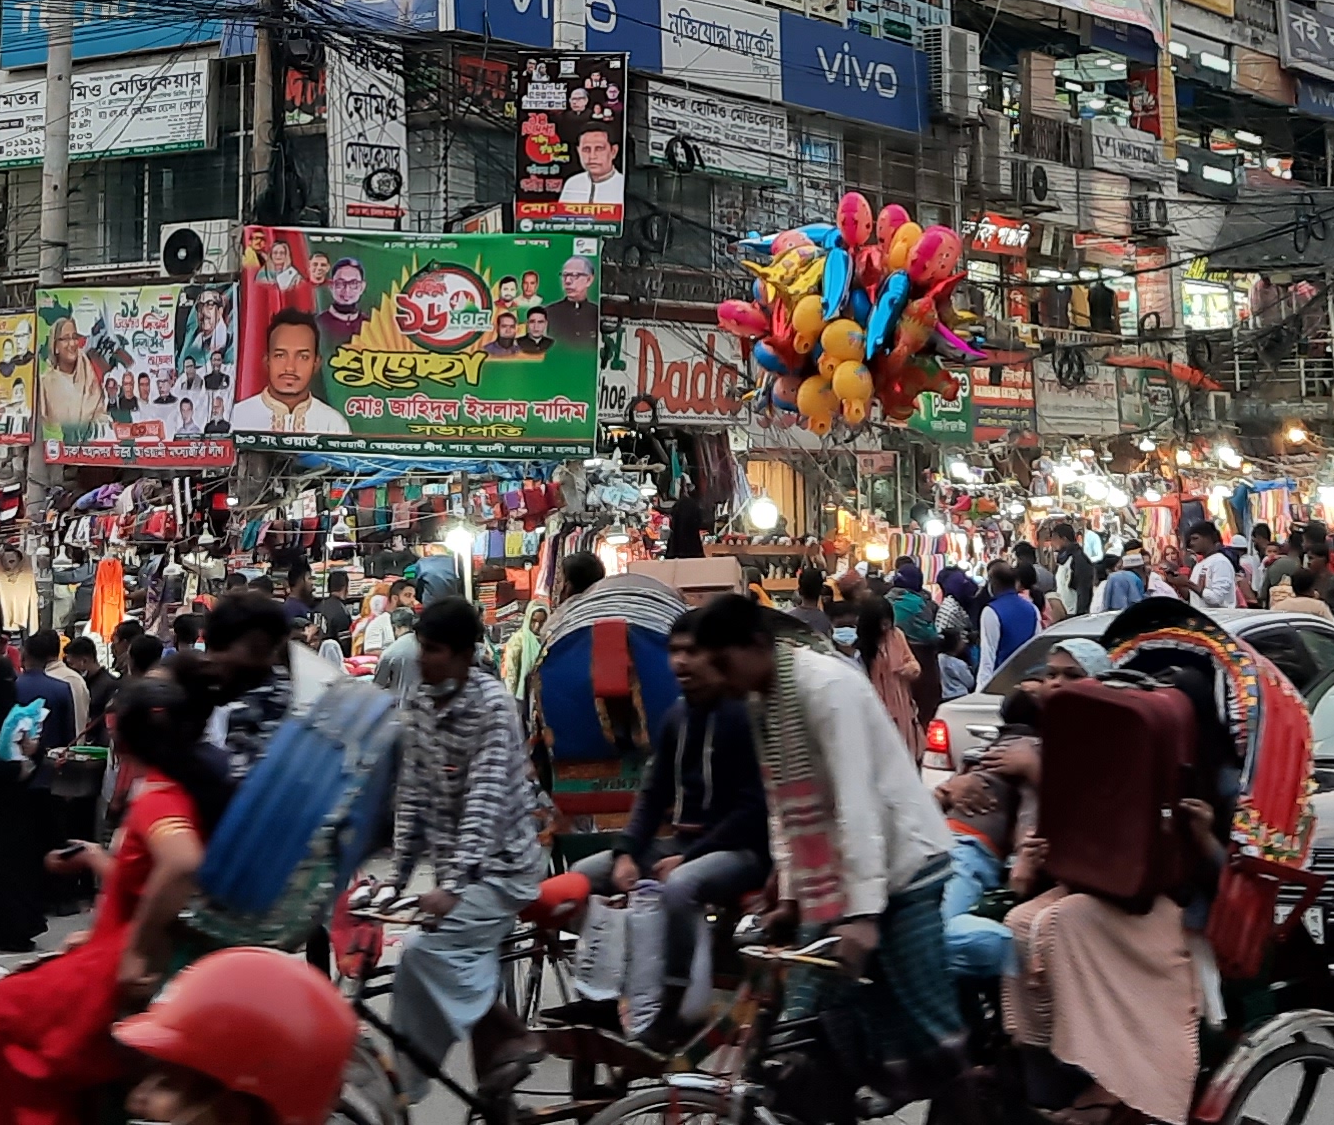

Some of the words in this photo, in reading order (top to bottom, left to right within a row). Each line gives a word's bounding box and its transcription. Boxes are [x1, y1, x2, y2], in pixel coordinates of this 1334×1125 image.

[667, 8, 731, 51] মুক্তিযোদ্ধা
[734, 25, 775, 61] মার্কেট
[1289, 9, 1322, 50] বই
[110, 71, 203, 97] মেডিকেয়ার
[816, 41, 898, 99] vivo
[120, 298, 140, 318] ১৬
[395, 294, 449, 335] ১৬
[329, 347, 490, 390] শুভেচ্ছা
[635, 328, 745, 416] Dada
[344, 395, 383, 418] মোঃ
[386, 393, 459, 423] জাহিদুল
[464, 395, 528, 421] ইসলাম
[534, 397, 589, 423] নাদিম
[599, 376, 627, 411] hoe
[281, 434, 323, 450] ওয়ার্ড,
[407, 423, 527, 439] সভাপতি
